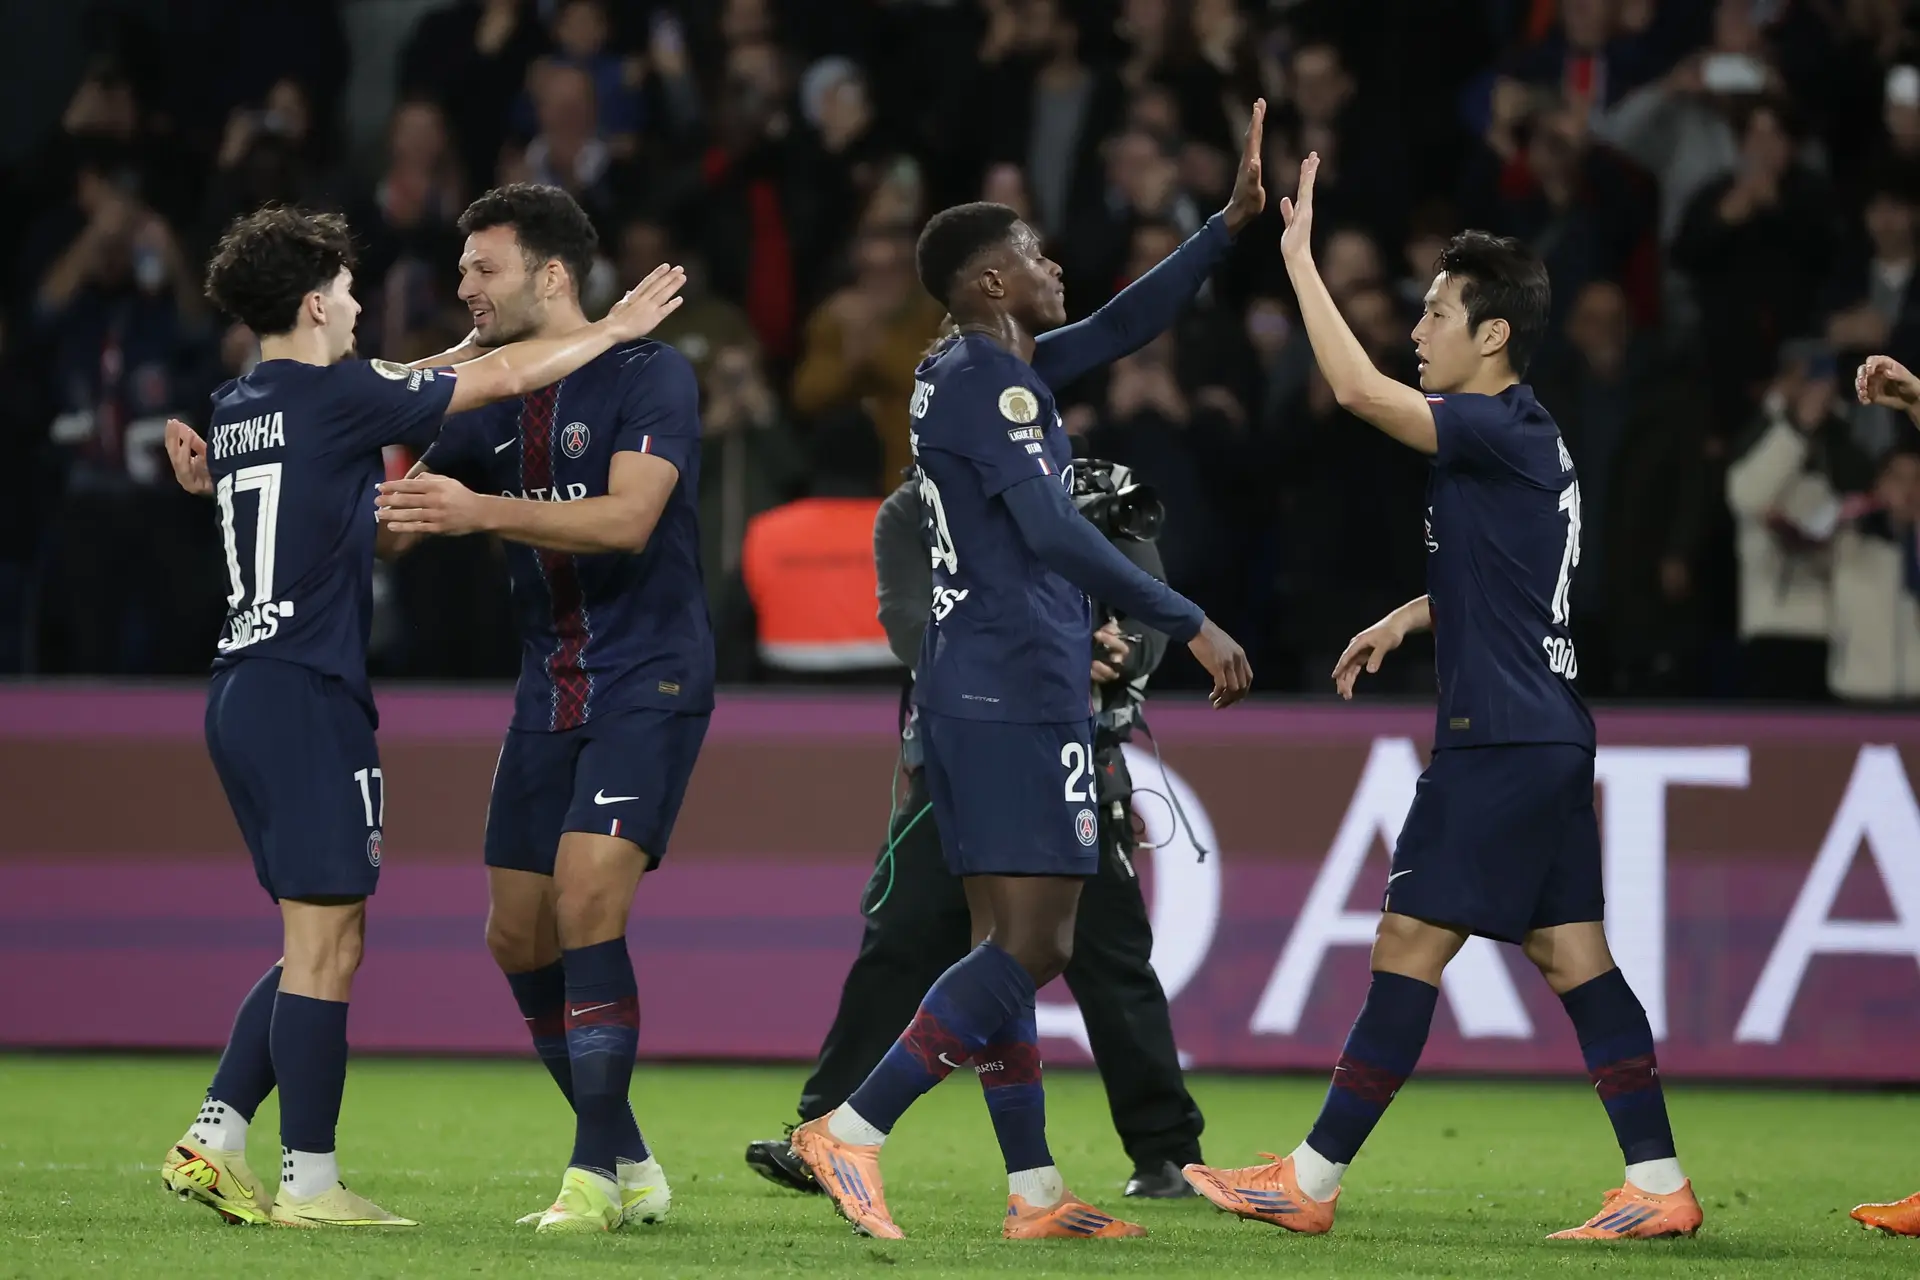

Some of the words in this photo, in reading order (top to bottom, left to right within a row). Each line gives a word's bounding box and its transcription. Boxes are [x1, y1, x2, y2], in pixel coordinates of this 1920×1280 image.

[212, 411, 286, 460] VITINHA
[565, 423, 587, 434] PARIS
[217, 463, 283, 608] 17
[354, 767, 384, 827] 17
